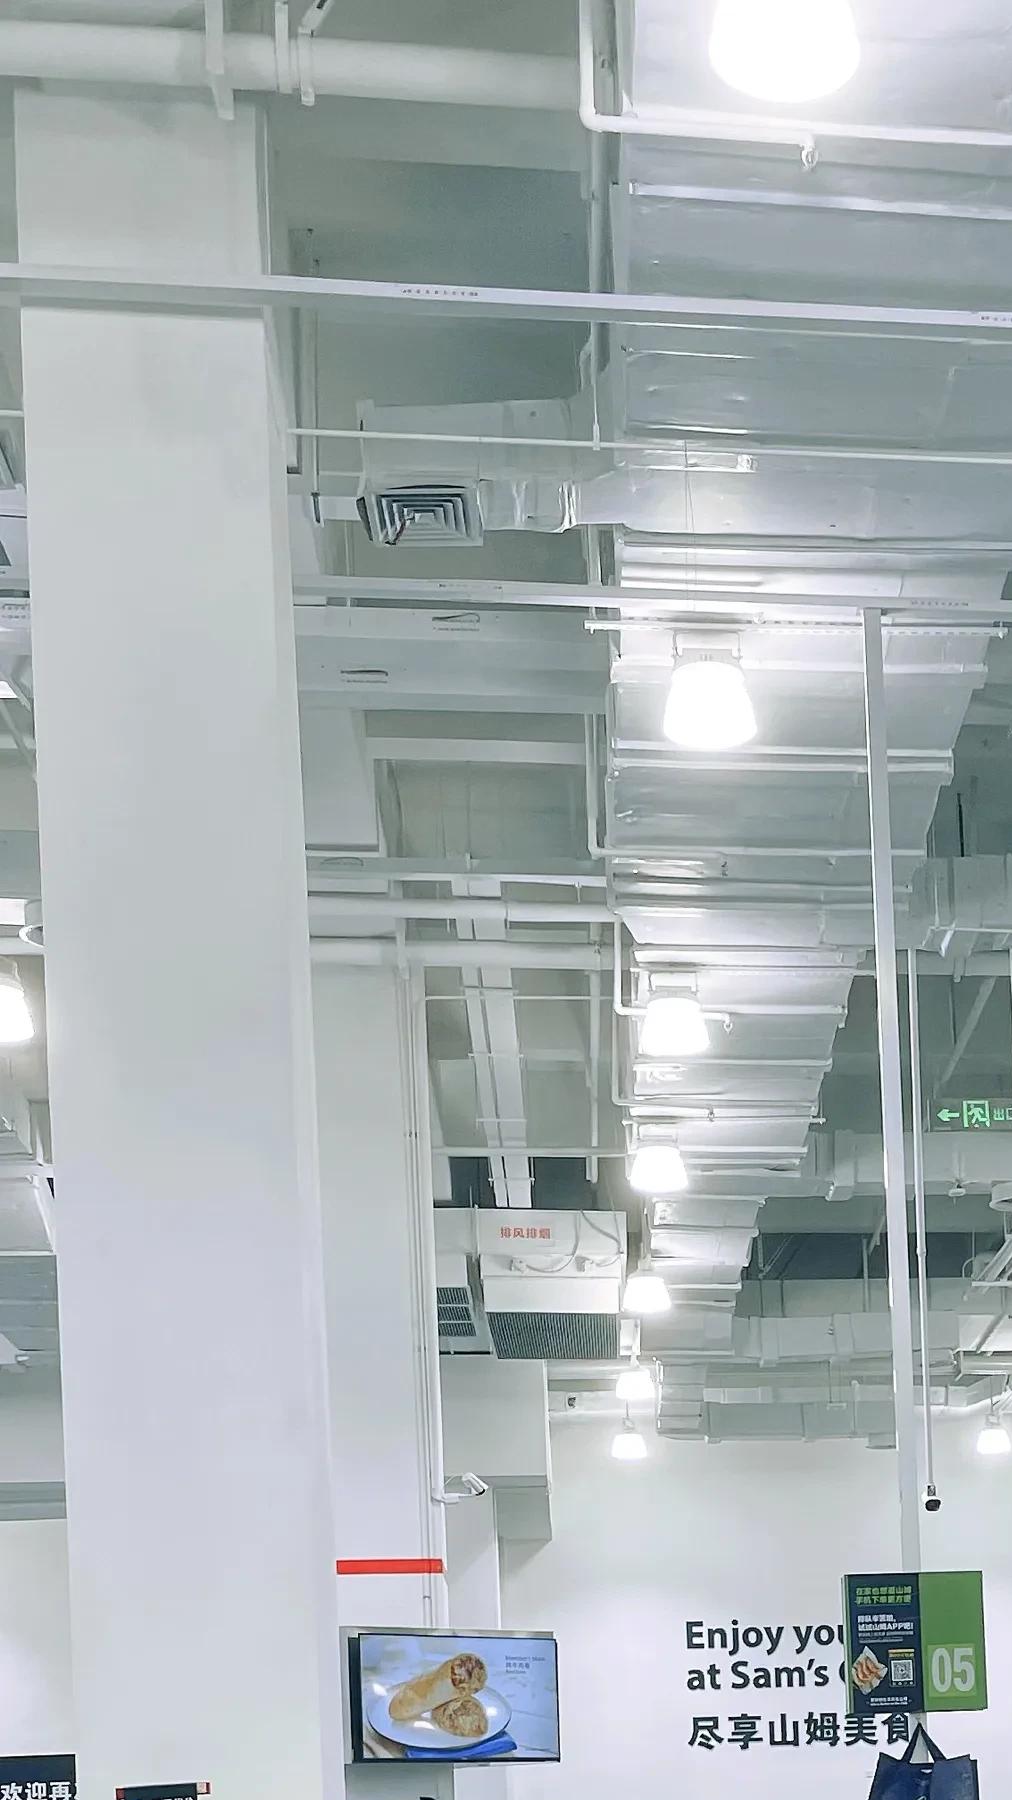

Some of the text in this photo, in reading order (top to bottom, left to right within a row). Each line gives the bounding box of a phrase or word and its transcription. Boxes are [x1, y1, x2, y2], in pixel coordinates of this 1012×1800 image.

[500, 1226, 551, 1241] 排风排烟
[685, 1620, 784, 1656] Enjoy
[687, 1663, 721, 1690] at
[731, 1658, 830, 1689] Sam's
[931, 1647, 975, 1692] 05
[688, 1711, 909, 1750] 尽享山姆美食
